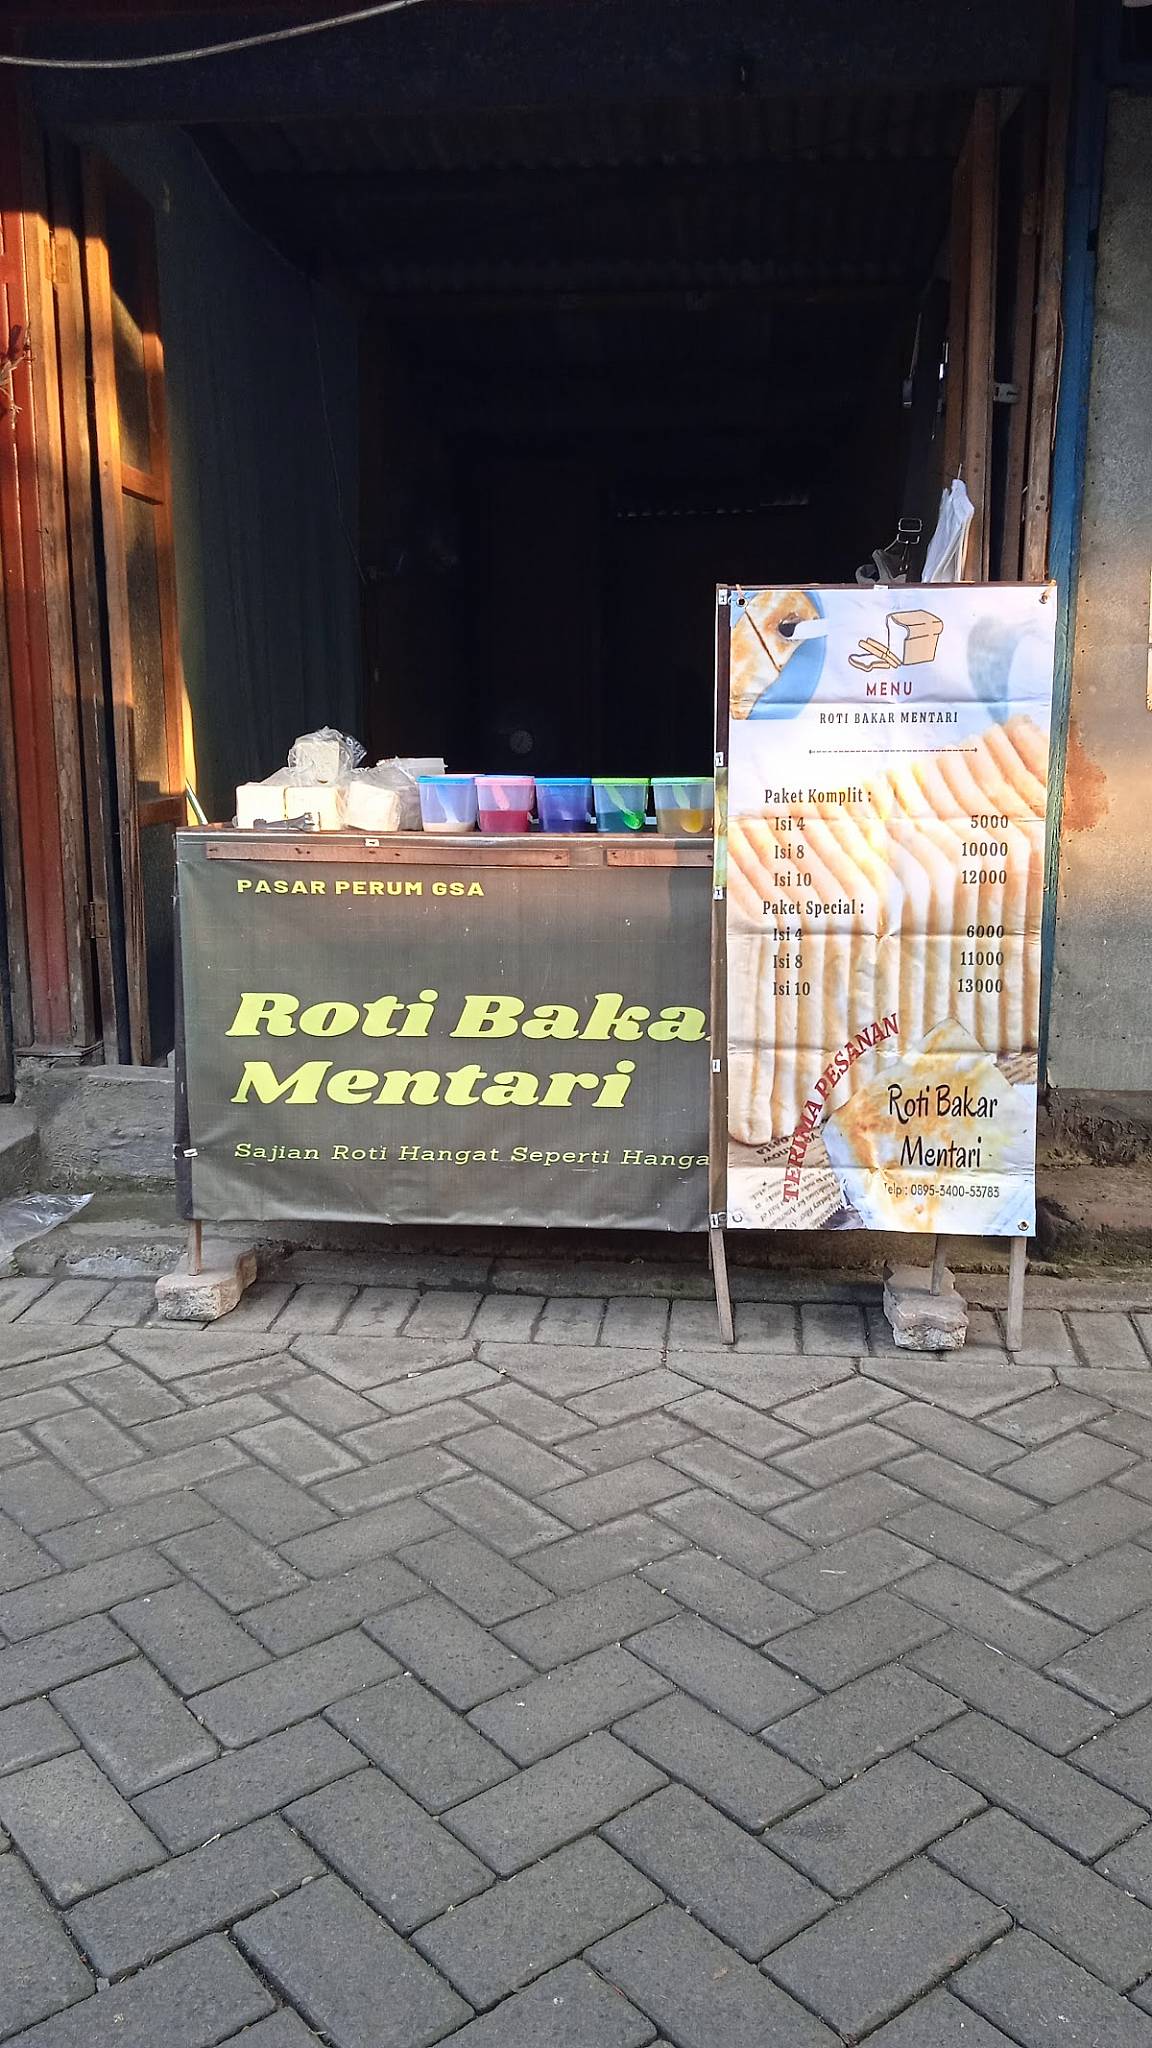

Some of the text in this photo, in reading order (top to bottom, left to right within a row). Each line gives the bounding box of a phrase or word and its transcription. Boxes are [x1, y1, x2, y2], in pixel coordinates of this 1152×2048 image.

[866, 681, 912, 696] MENU
[820, 712, 958, 724] ROTI BAKAR MENTARI
[764, 788, 803, 804] Paket
[808, 787, 862, 806] Komplit
[775, 816, 806, 831] Isi 4
[970, 815, 1009, 828] 5000
[774, 844, 804, 860] Isi 8
[962, 842, 1008, 856] 10000
[774, 872, 812, 886] Isi 10
[962, 870, 1008, 886] 12000
[236, 878, 485, 897] PASAR PERUM GSA
[762, 900, 801, 914] Paket
[806, 900, 856, 918] Special
[774, 926, 804, 941] Isi 4
[966, 925, 1006, 938] 6000
[774, 954, 803, 970] Isi 8
[960, 951, 1004, 966] 11000
[774, 980, 810, 996] Isi 10
[958, 978, 1004, 993] 13000
[224, 988, 712, 1043] Roti Baka
[230, 1058, 636, 1109] Mentari
[783, 1100, 823, 1203] TERIMA
[815, 1013, 899, 1101] PESANAN
[887, 1083, 998, 1124] Roti Bakar
[234, 1142, 711, 1167] Sajian Roti Hangat Seperti Hanga
[900, 1135, 982, 1168] Mentari
[910, 1184, 1000, 1198] 0895-3400-53783
